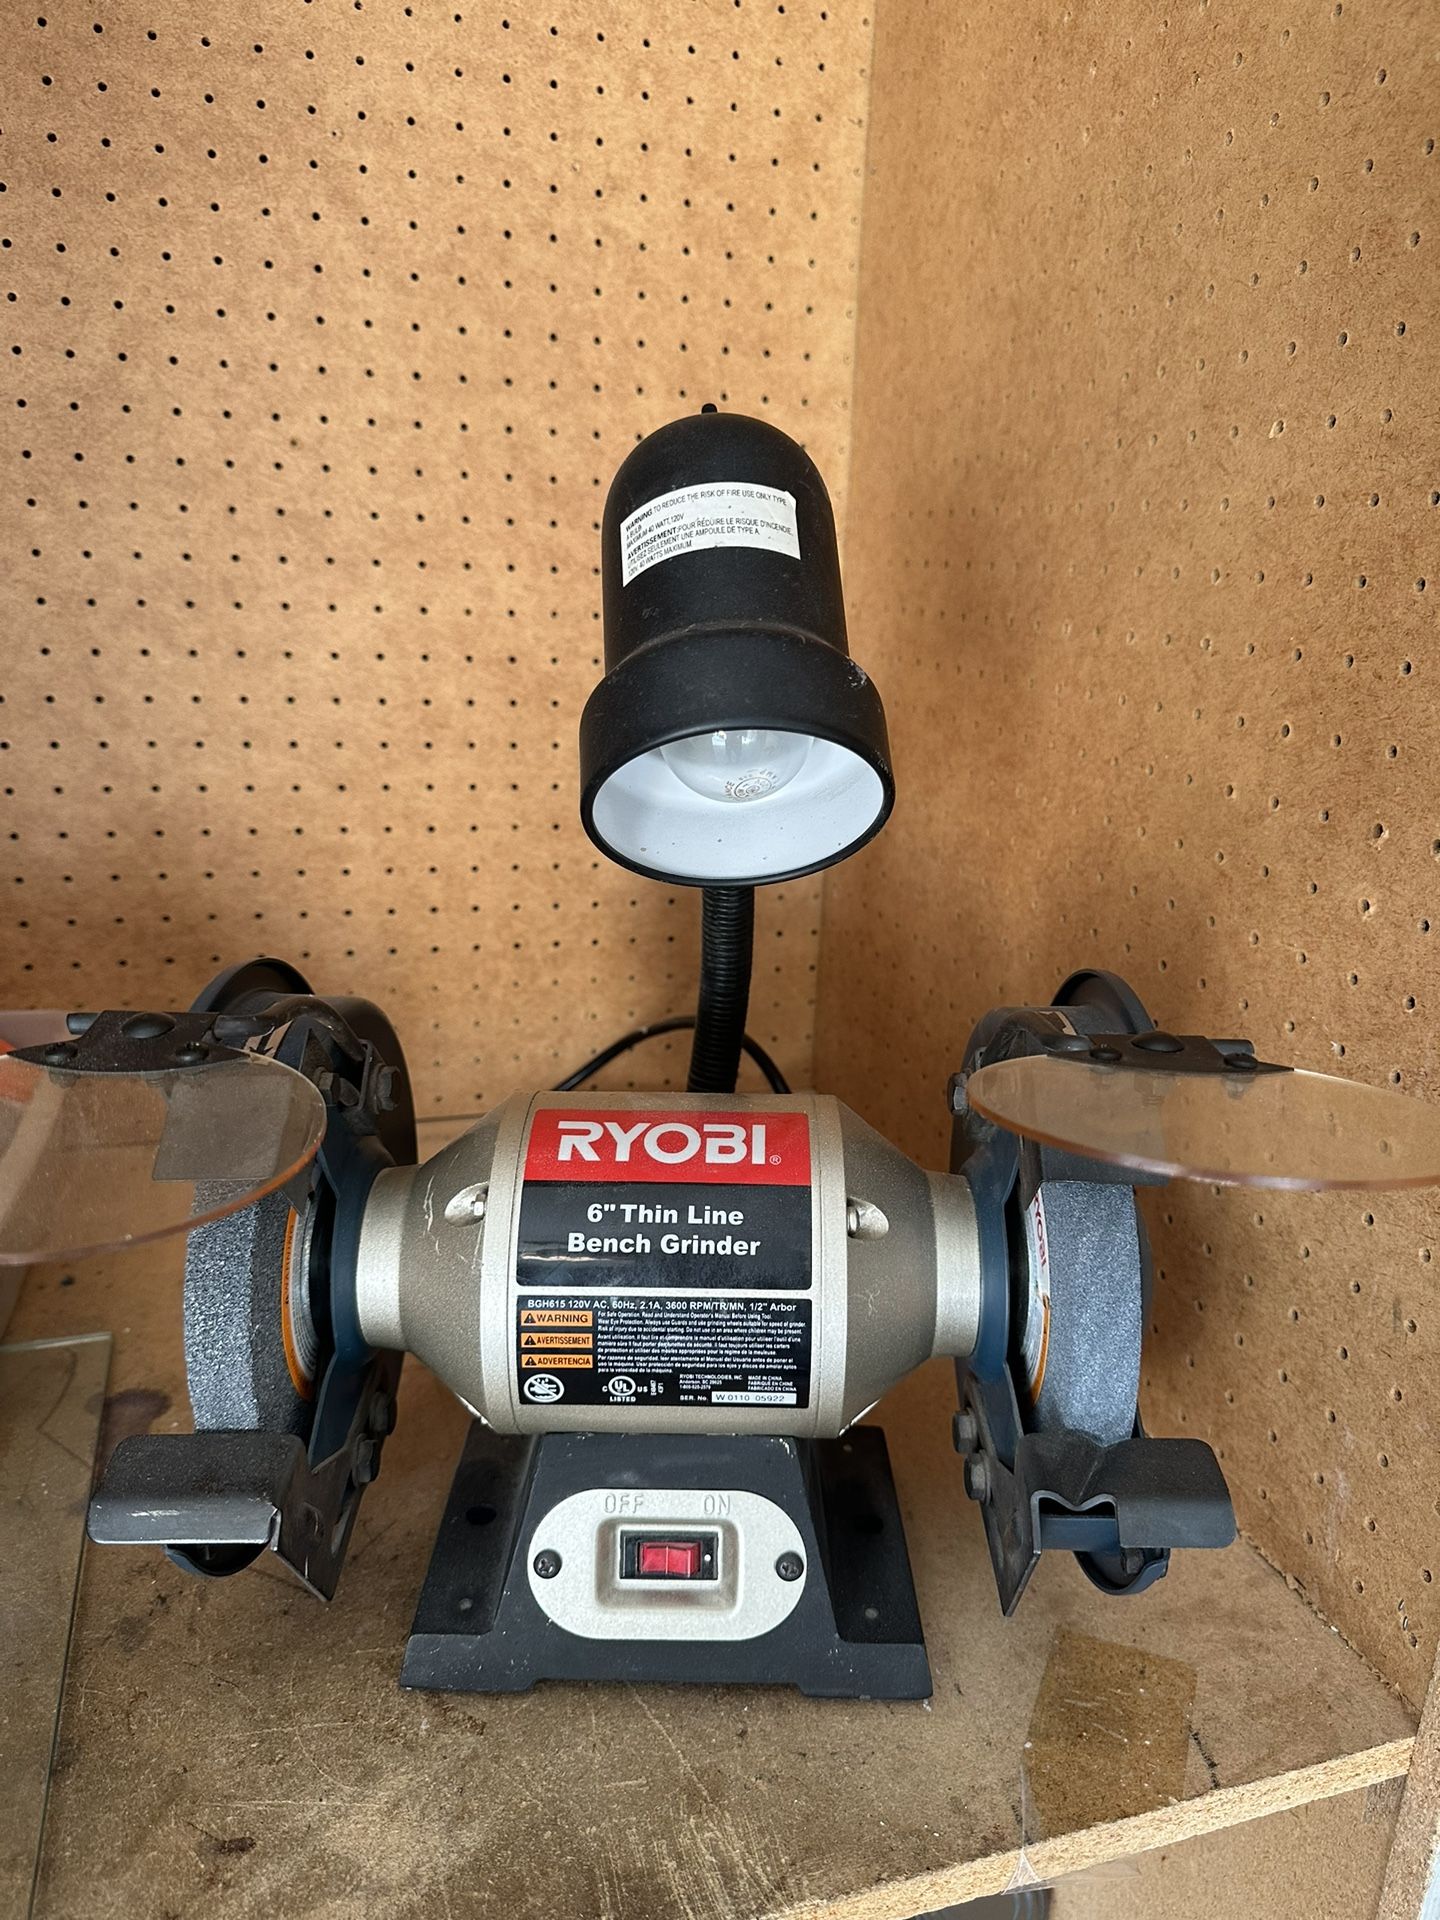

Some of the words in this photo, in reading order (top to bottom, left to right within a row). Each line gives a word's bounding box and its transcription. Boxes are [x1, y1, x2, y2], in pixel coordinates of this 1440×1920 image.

[626, 509, 652, 532] WARNING
[654, 504, 661, 513] TO
[662, 495, 686, 509] REDUCE
[701, 490, 715, 498] RISK
[756, 491, 771, 500] ONLY
[736, 518, 758, 526] RISQUE
[627, 529, 648, 549] MAXIMUM
[648, 534, 679, 554] SEULEMENT
[681, 530, 693, 540] UNE
[695, 526, 726, 536] AMPOULE
[737, 526, 752, 534] TYPE
[558, 1120, 766, 1164] RYOBI
[587, 1204, 616, 1222] 6"
[620, 1204, 678, 1224] Thin
[688, 1206, 744, 1225] Line
[567, 1232, 650, 1253] Bench
[660, 1234, 760, 1256] Grinder
[528, 1300, 565, 1308] BGH615
[568, 1300, 590, 1308] 120V
[612, 1301, 637, 1310] 60Hz,
[640, 1301, 663, 1310] 2.1A,
[665, 1302, 687, 1310] 3600
[690, 1302, 746, 1311] RPM/TR/MN,
[750, 1303, 768, 1311] 1/2"
[770, 1303, 796, 1311] Arbor
[537, 1314, 588, 1323] WARNING
[537, 1336, 590, 1345] AVERTISSEMENT
[615, 1381, 630, 1392] UL
[604, 1493, 644, 1514] OFF
[703, 1495, 731, 1515] ON
